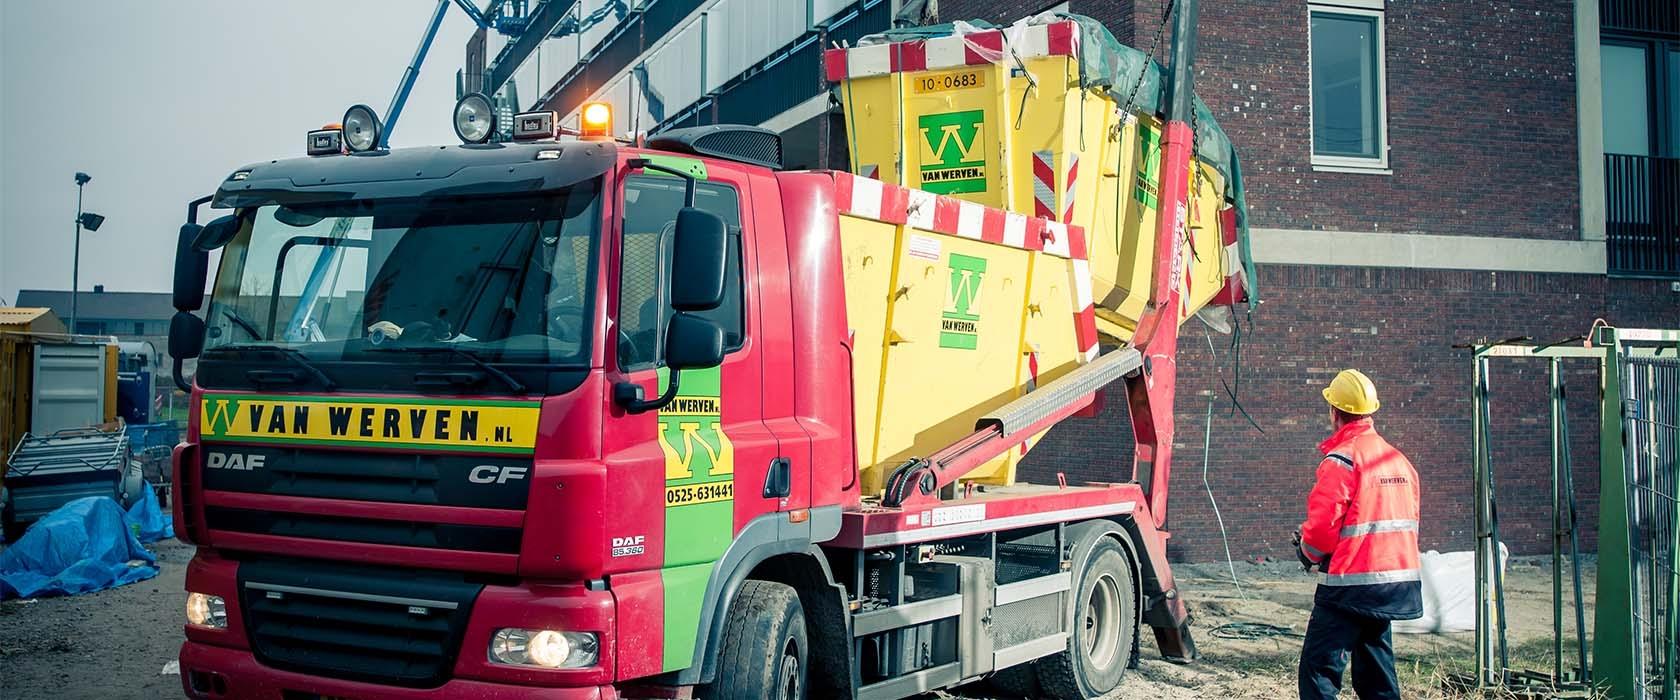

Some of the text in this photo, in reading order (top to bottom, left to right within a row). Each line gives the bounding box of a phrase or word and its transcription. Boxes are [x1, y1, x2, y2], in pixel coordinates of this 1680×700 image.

[922, 170, 940, 181] VAN
[942, 319, 954, 331] VAN
[250, 404, 309, 434] VAN
[207, 452, 266, 470] DAF
[468, 465, 528, 484] CF
[612, 535, 645, 547] DAF
